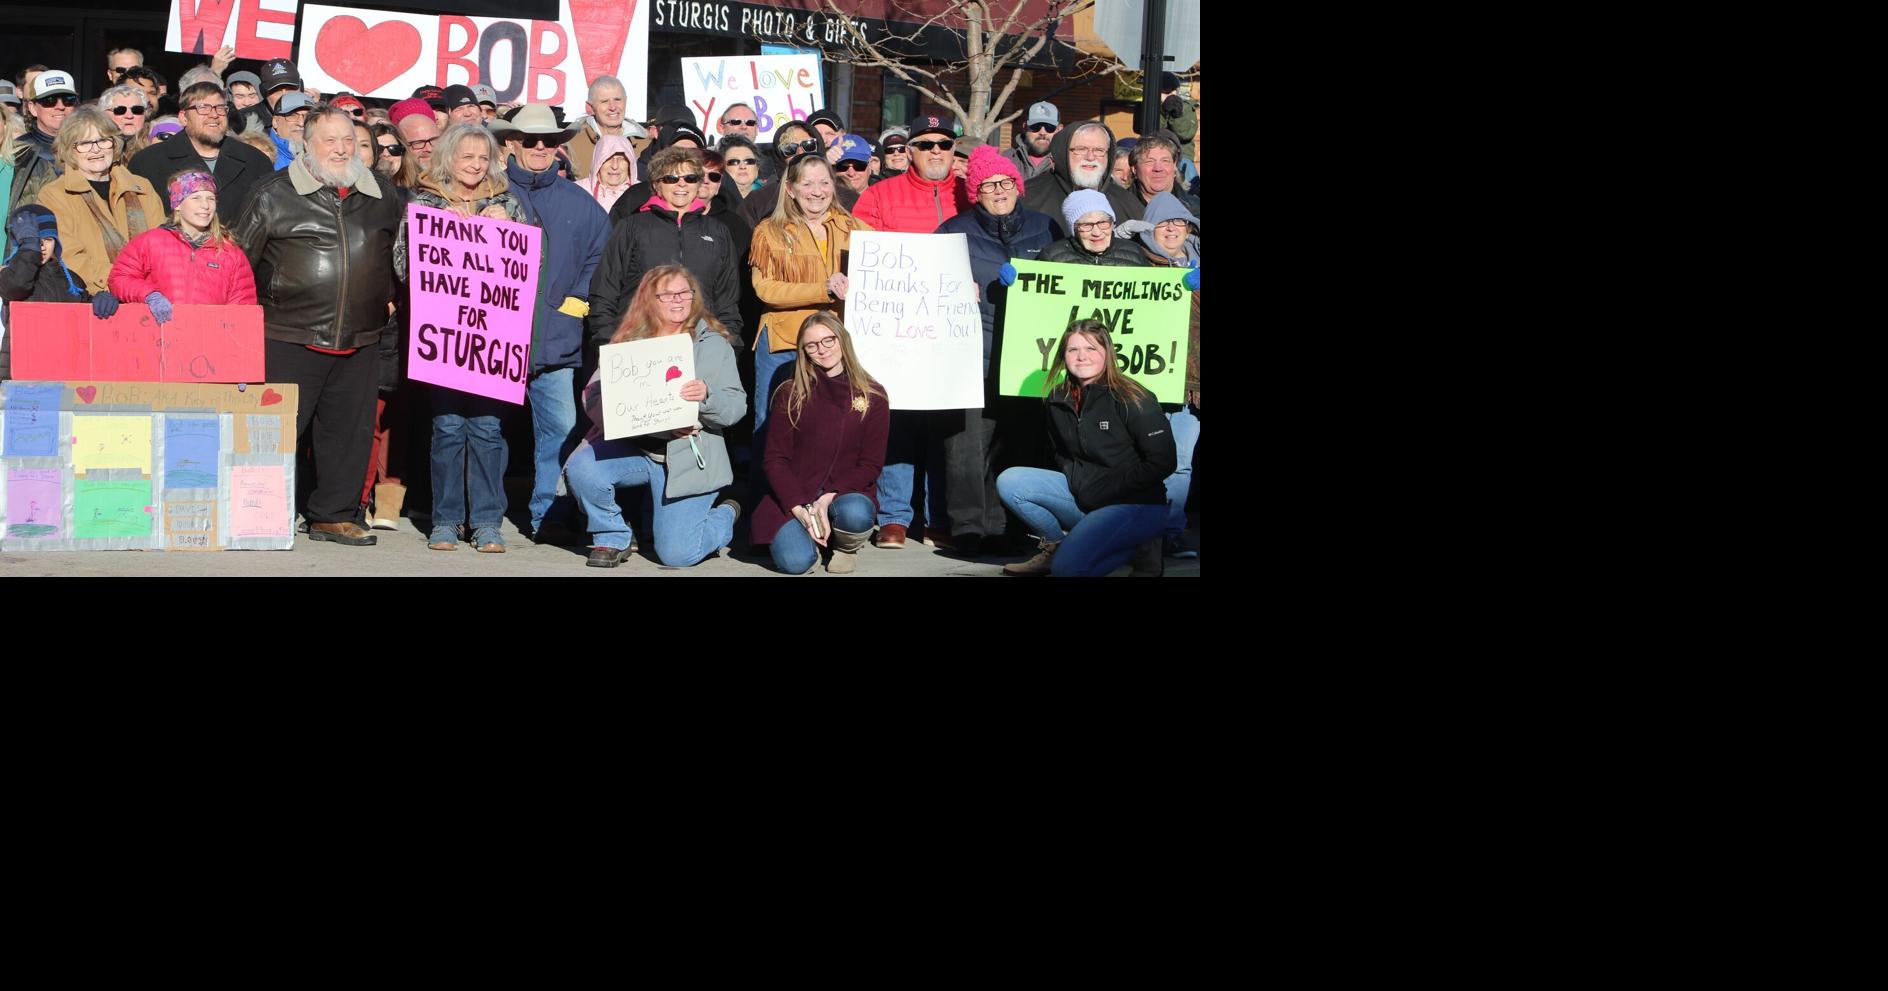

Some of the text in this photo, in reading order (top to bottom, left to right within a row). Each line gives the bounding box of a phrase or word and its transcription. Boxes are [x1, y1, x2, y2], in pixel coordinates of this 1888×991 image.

[179, 0, 296, 60] WE
[655, 0, 868, 47] STURGIS PHOTO & GIFTS
[692, 60, 815, 92] We love
[415, 213, 528, 256] THANK YOU
[418, 244, 528, 282] FOR ALL YOU
[860, 240, 917, 273] Bob,
[419, 270, 520, 312] HAVE DONE
[857, 269, 962, 295] Thanks For
[1017, 272, 1183, 302] THE MECHLINGS
[457, 305, 488, 331] FOR
[854, 291, 905, 320] Being
[915, 295, 929, 316] A
[852, 315, 882, 337] We
[895, 318, 937, 340] Love
[417, 323, 530, 384] STURGIS!
[608, 353, 639, 384] Bob
